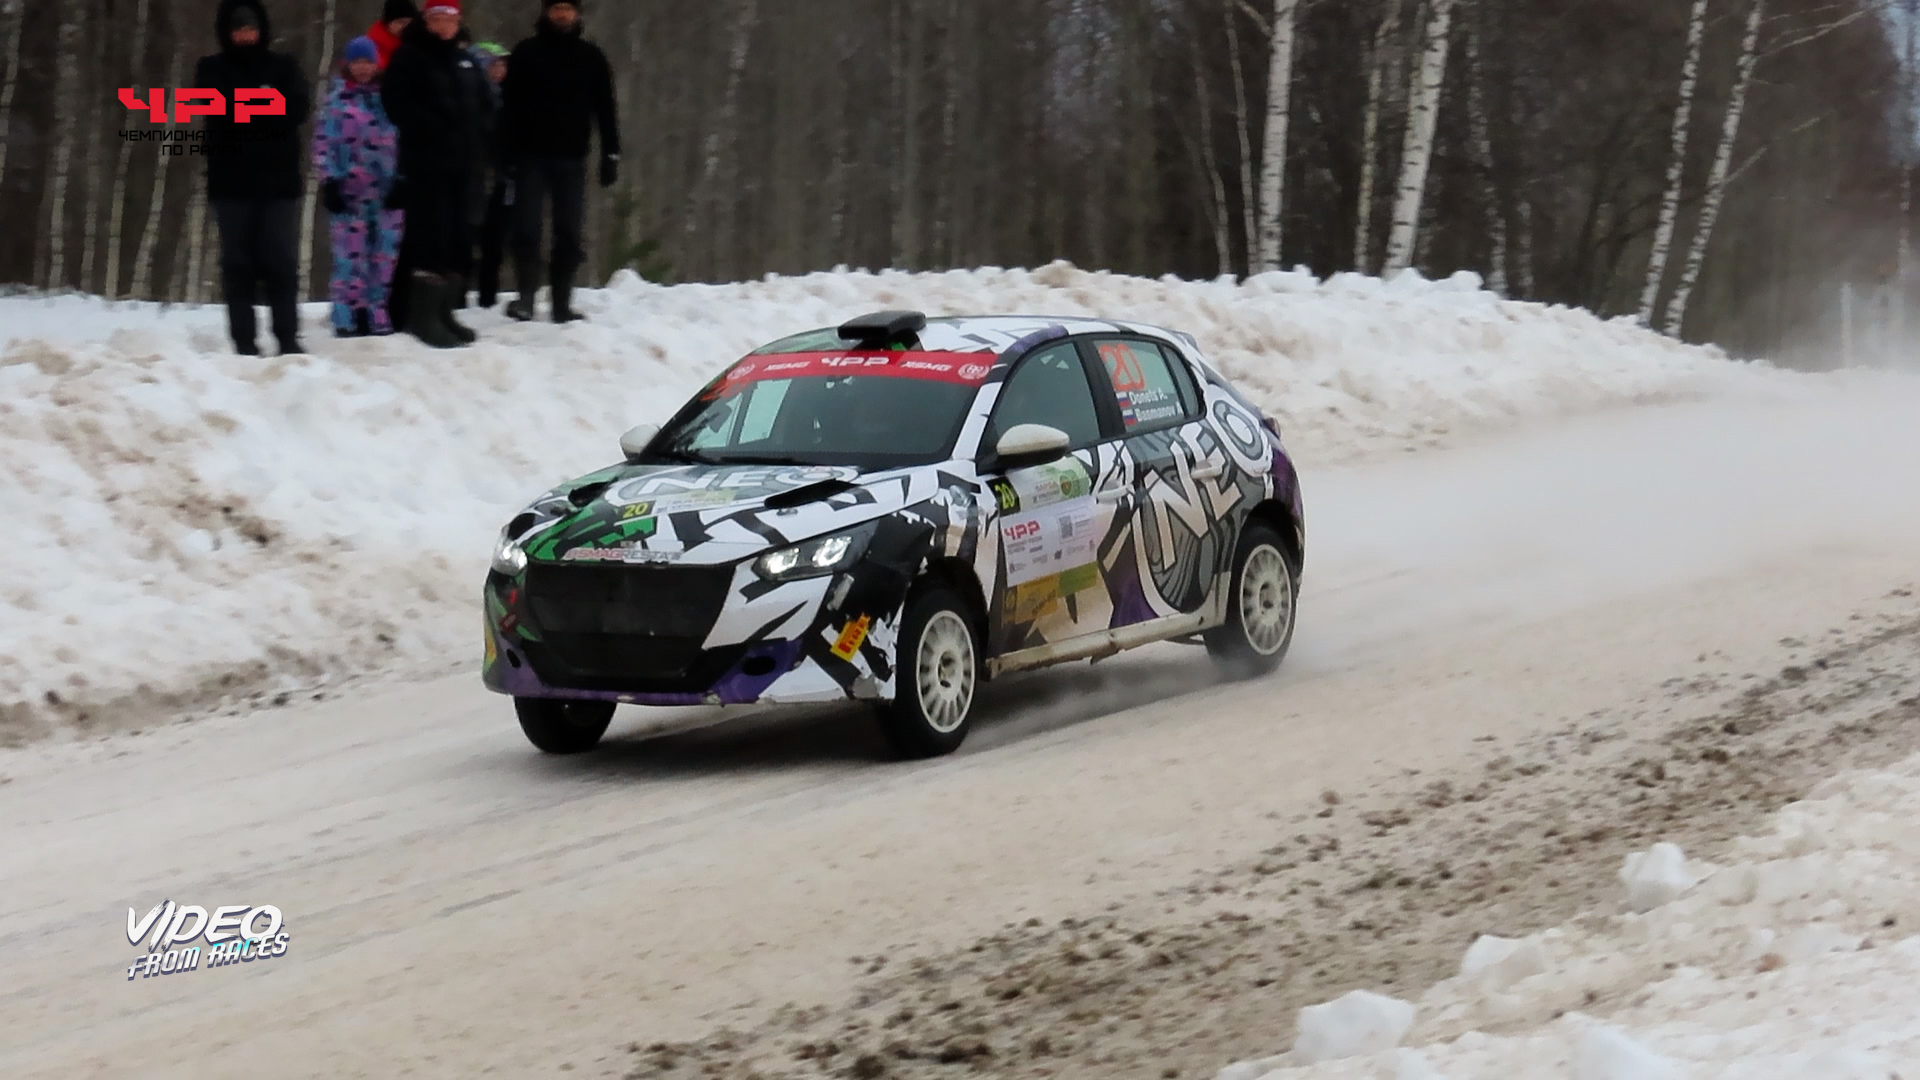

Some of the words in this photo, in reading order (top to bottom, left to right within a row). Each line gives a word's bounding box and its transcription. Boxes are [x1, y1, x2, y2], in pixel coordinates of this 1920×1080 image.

[1100, 343, 1145, 391] 20
[994, 482, 1016, 510] 20
[622, 501, 649, 519] 20
[1003, 520, 1041, 541] ЧРР
